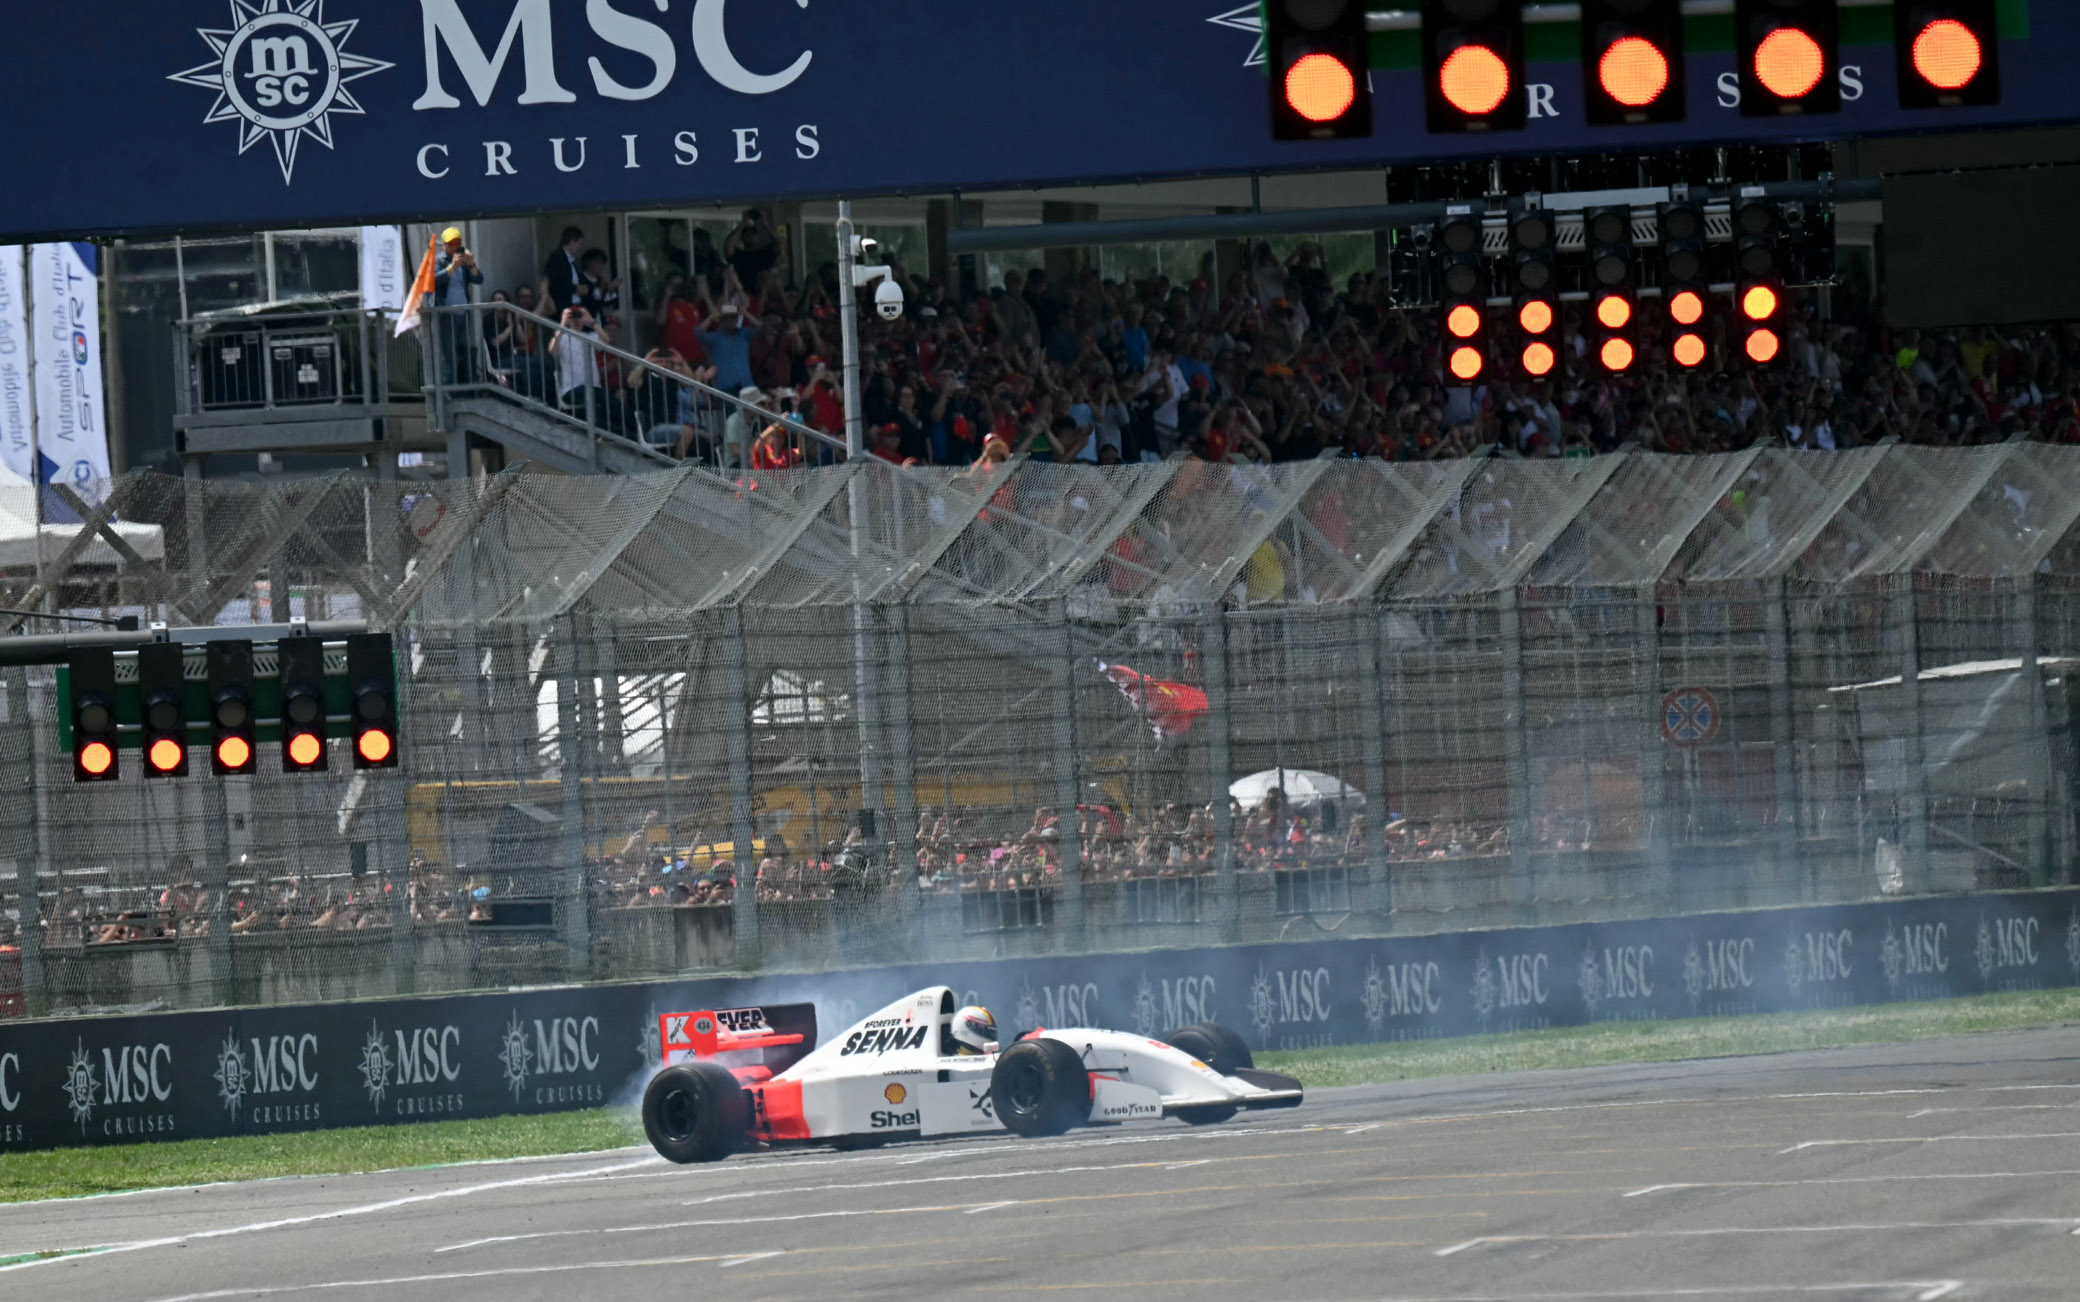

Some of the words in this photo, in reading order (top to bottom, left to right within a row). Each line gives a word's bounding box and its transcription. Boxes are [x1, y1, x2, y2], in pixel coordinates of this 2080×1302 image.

[412, 0, 813, 110] MSC
[416, 124, 821, 179] CRUISES
[52, 305, 68, 343] Club
[52, 352, 75, 442] Automobile
[1706, 937, 1755, 991] MSC
[1805, 928, 1854, 981] MSC
[1903, 921, 1950, 974] MSC
[1996, 915, 2040, 968] MSC
[1276, 966, 1332, 1023] MSC
[1387, 960, 1442, 1016] MSC
[1497, 952, 1550, 1008] MSC
[1603, 945, 1655, 999] MSC
[1042, 982, 1099, 1029] MSC
[1160, 974, 1217, 1031] MSC
[251, 1033, 318, 1094] MSC
[394, 1025, 461, 1085] MSC
[533, 1016, 601, 1075] MSC
[840, 1025, 929, 1056] SENNA
[102, 1043, 172, 1105] MSC
[535, 1083, 603, 1104] CRUISES
[104, 1114, 175, 1136] CRUISES
[253, 1103, 320, 1123] CRUISES
[396, 1094, 464, 1115] CRUISES
[870, 1108, 921, 1129] Shel
